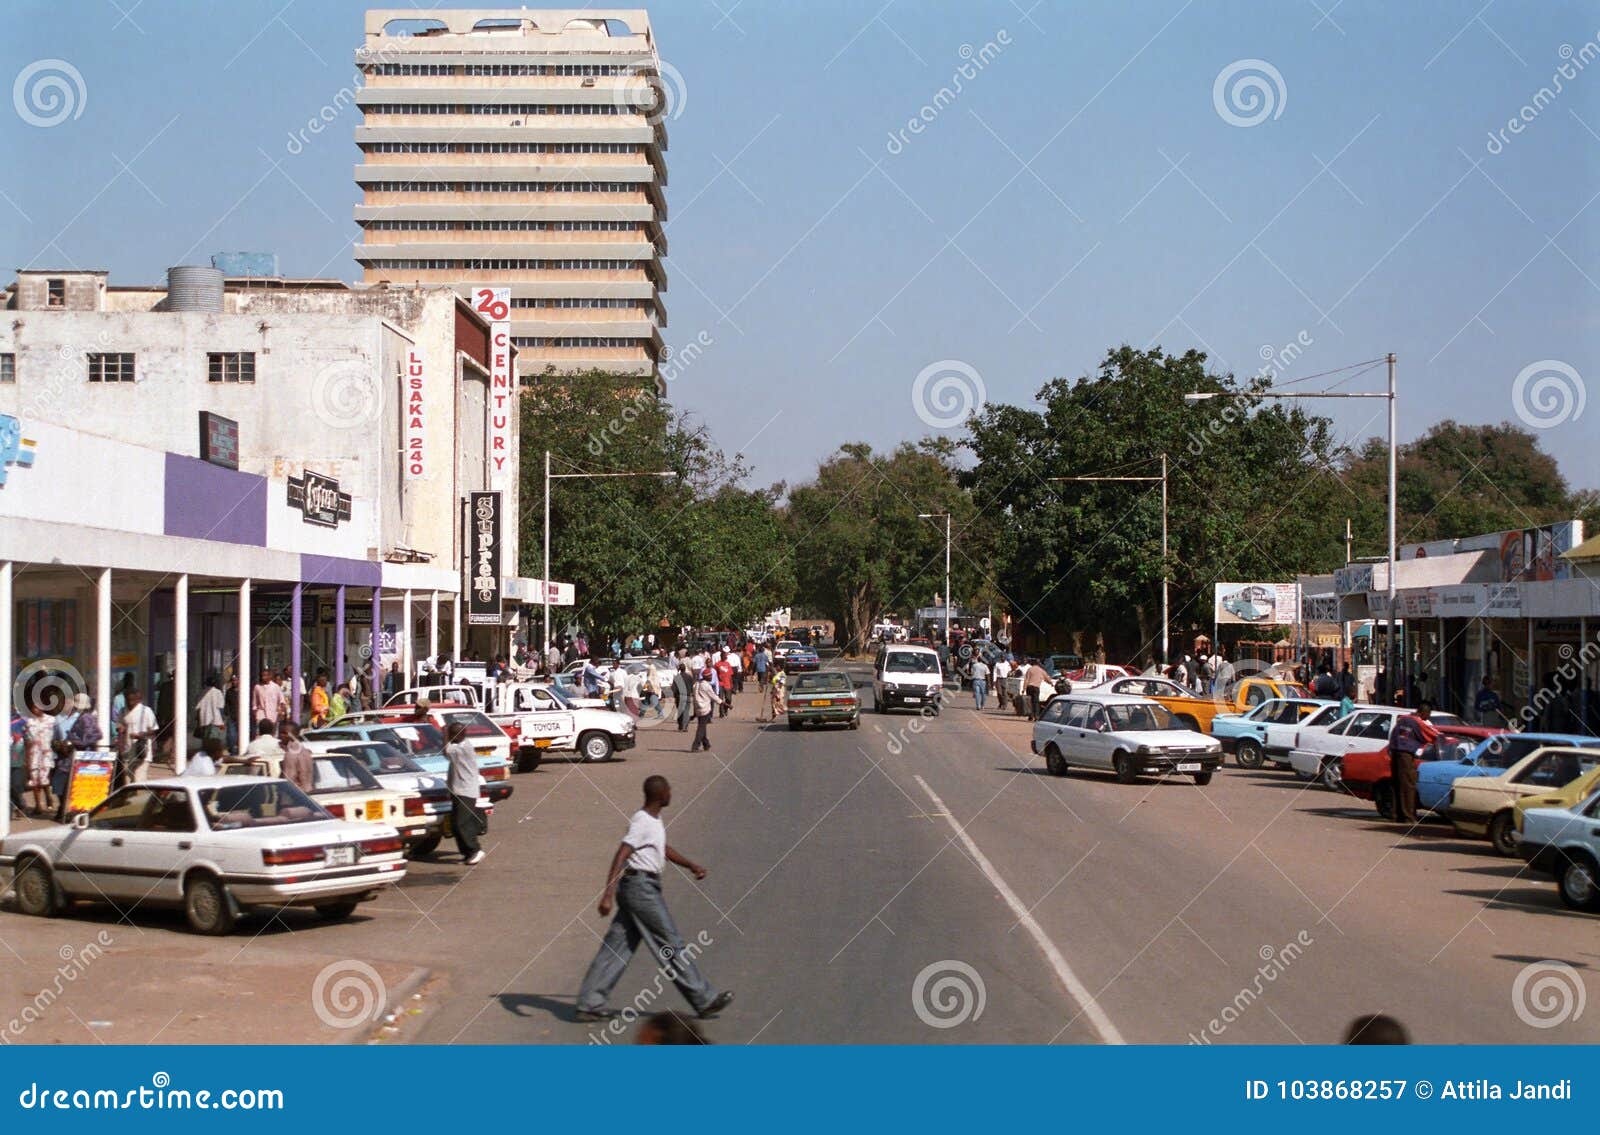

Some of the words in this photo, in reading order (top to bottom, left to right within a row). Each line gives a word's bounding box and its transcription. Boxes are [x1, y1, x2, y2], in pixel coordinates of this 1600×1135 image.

[478, 288, 509, 321] 20
[409, 352, 423, 428] LUSAKA
[494, 333, 507, 471] CENTURY
[409, 437, 423, 475] 240
[474, 495, 497, 603] Supreme
[534, 722, 560, 731] TOYOTA
